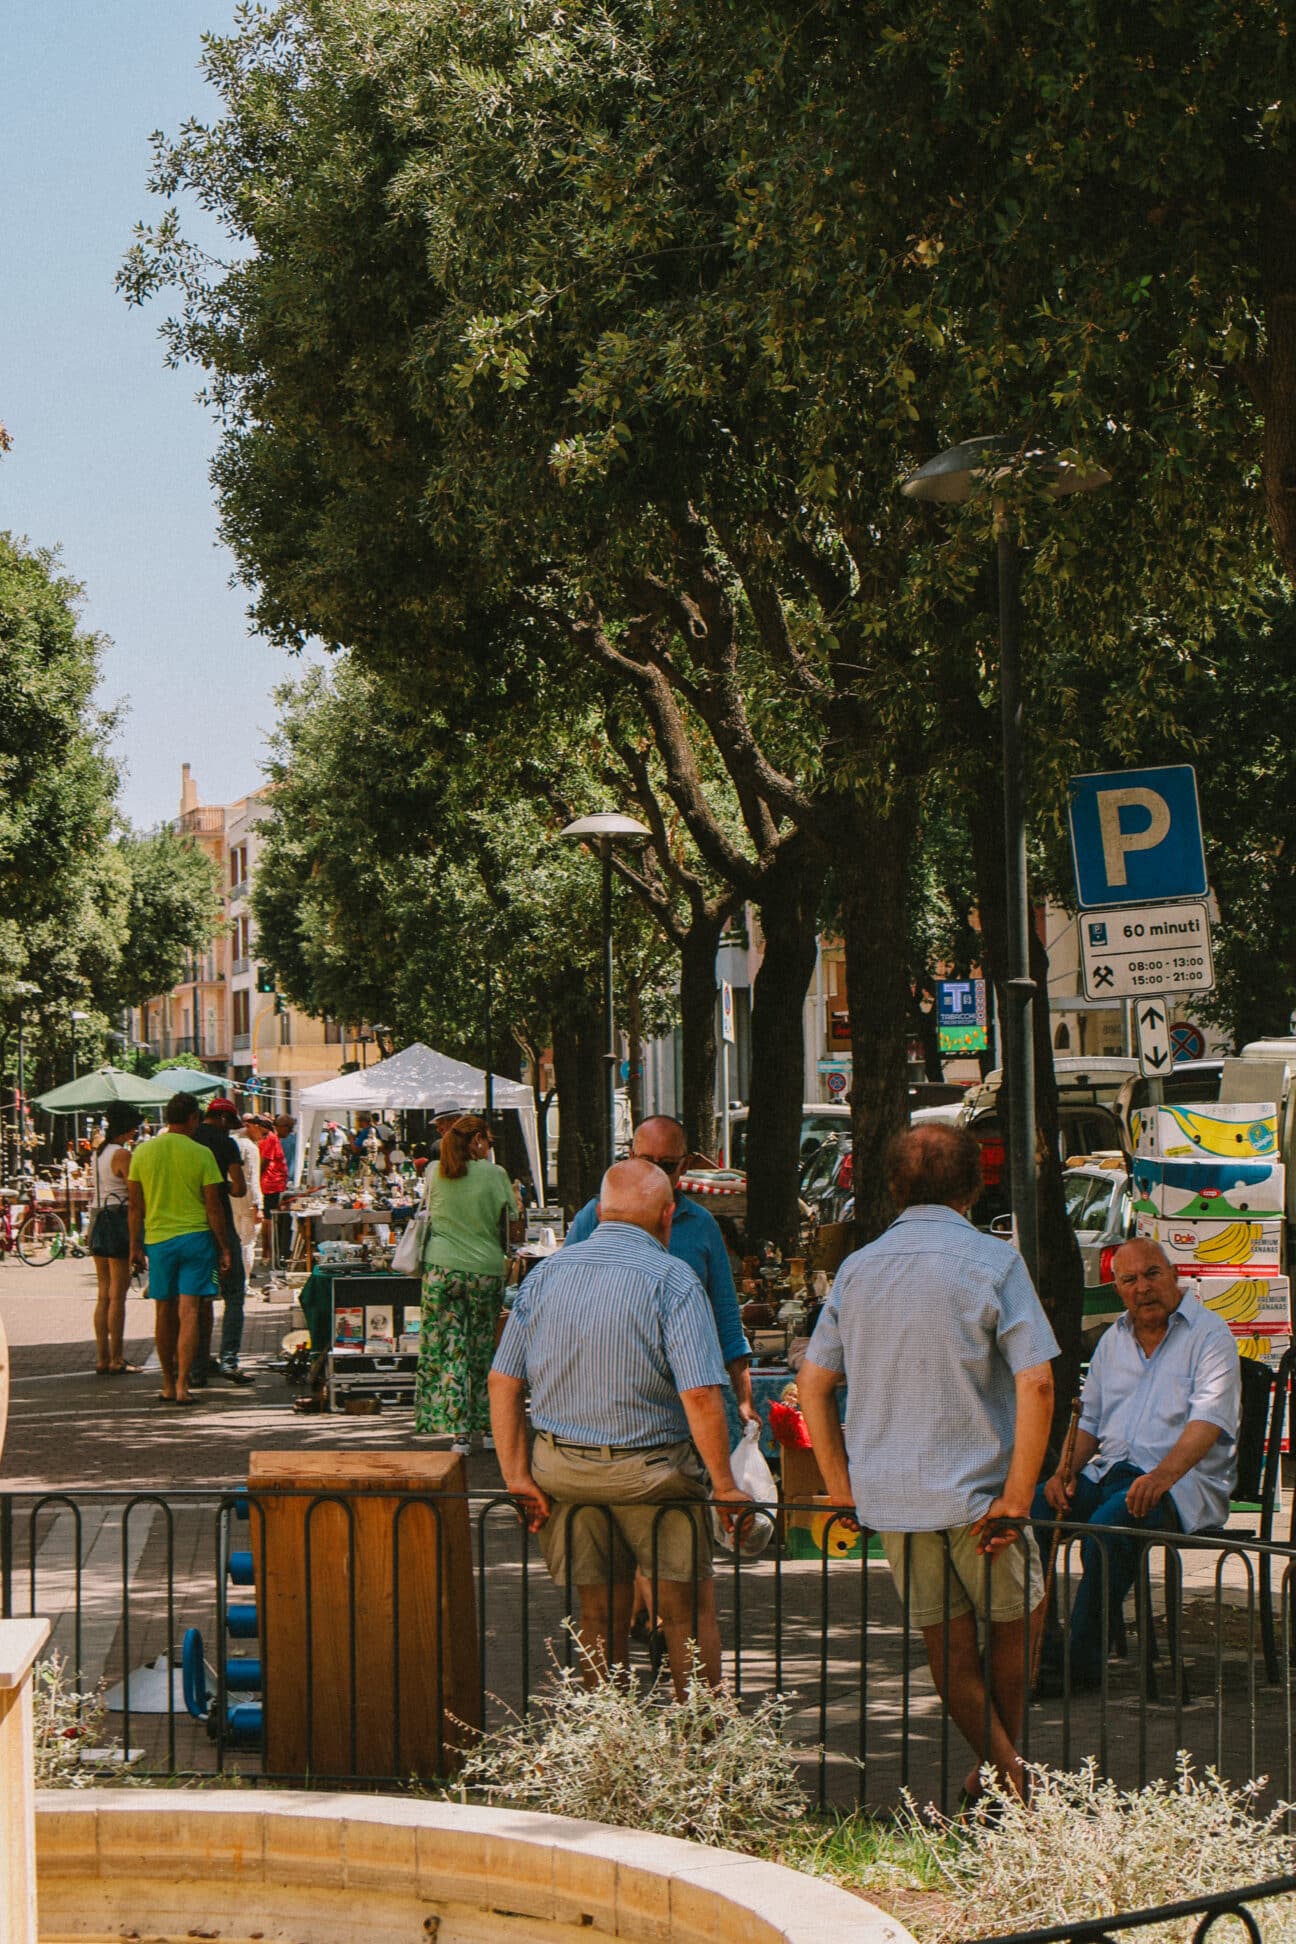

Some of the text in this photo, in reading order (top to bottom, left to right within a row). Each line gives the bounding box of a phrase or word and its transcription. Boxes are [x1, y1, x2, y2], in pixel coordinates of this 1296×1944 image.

[1096, 787, 1171, 887] P
[1123, 918, 1201, 938] 60 minuti
[1128, 961, 1163, 972] 08:00
[1173, 957, 1204, 968] 13:00
[1132, 975, 1163, 985] 15:00
[1172, 971, 1203, 981] 21:00
[1174, 1233, 1196, 1243] Dole
